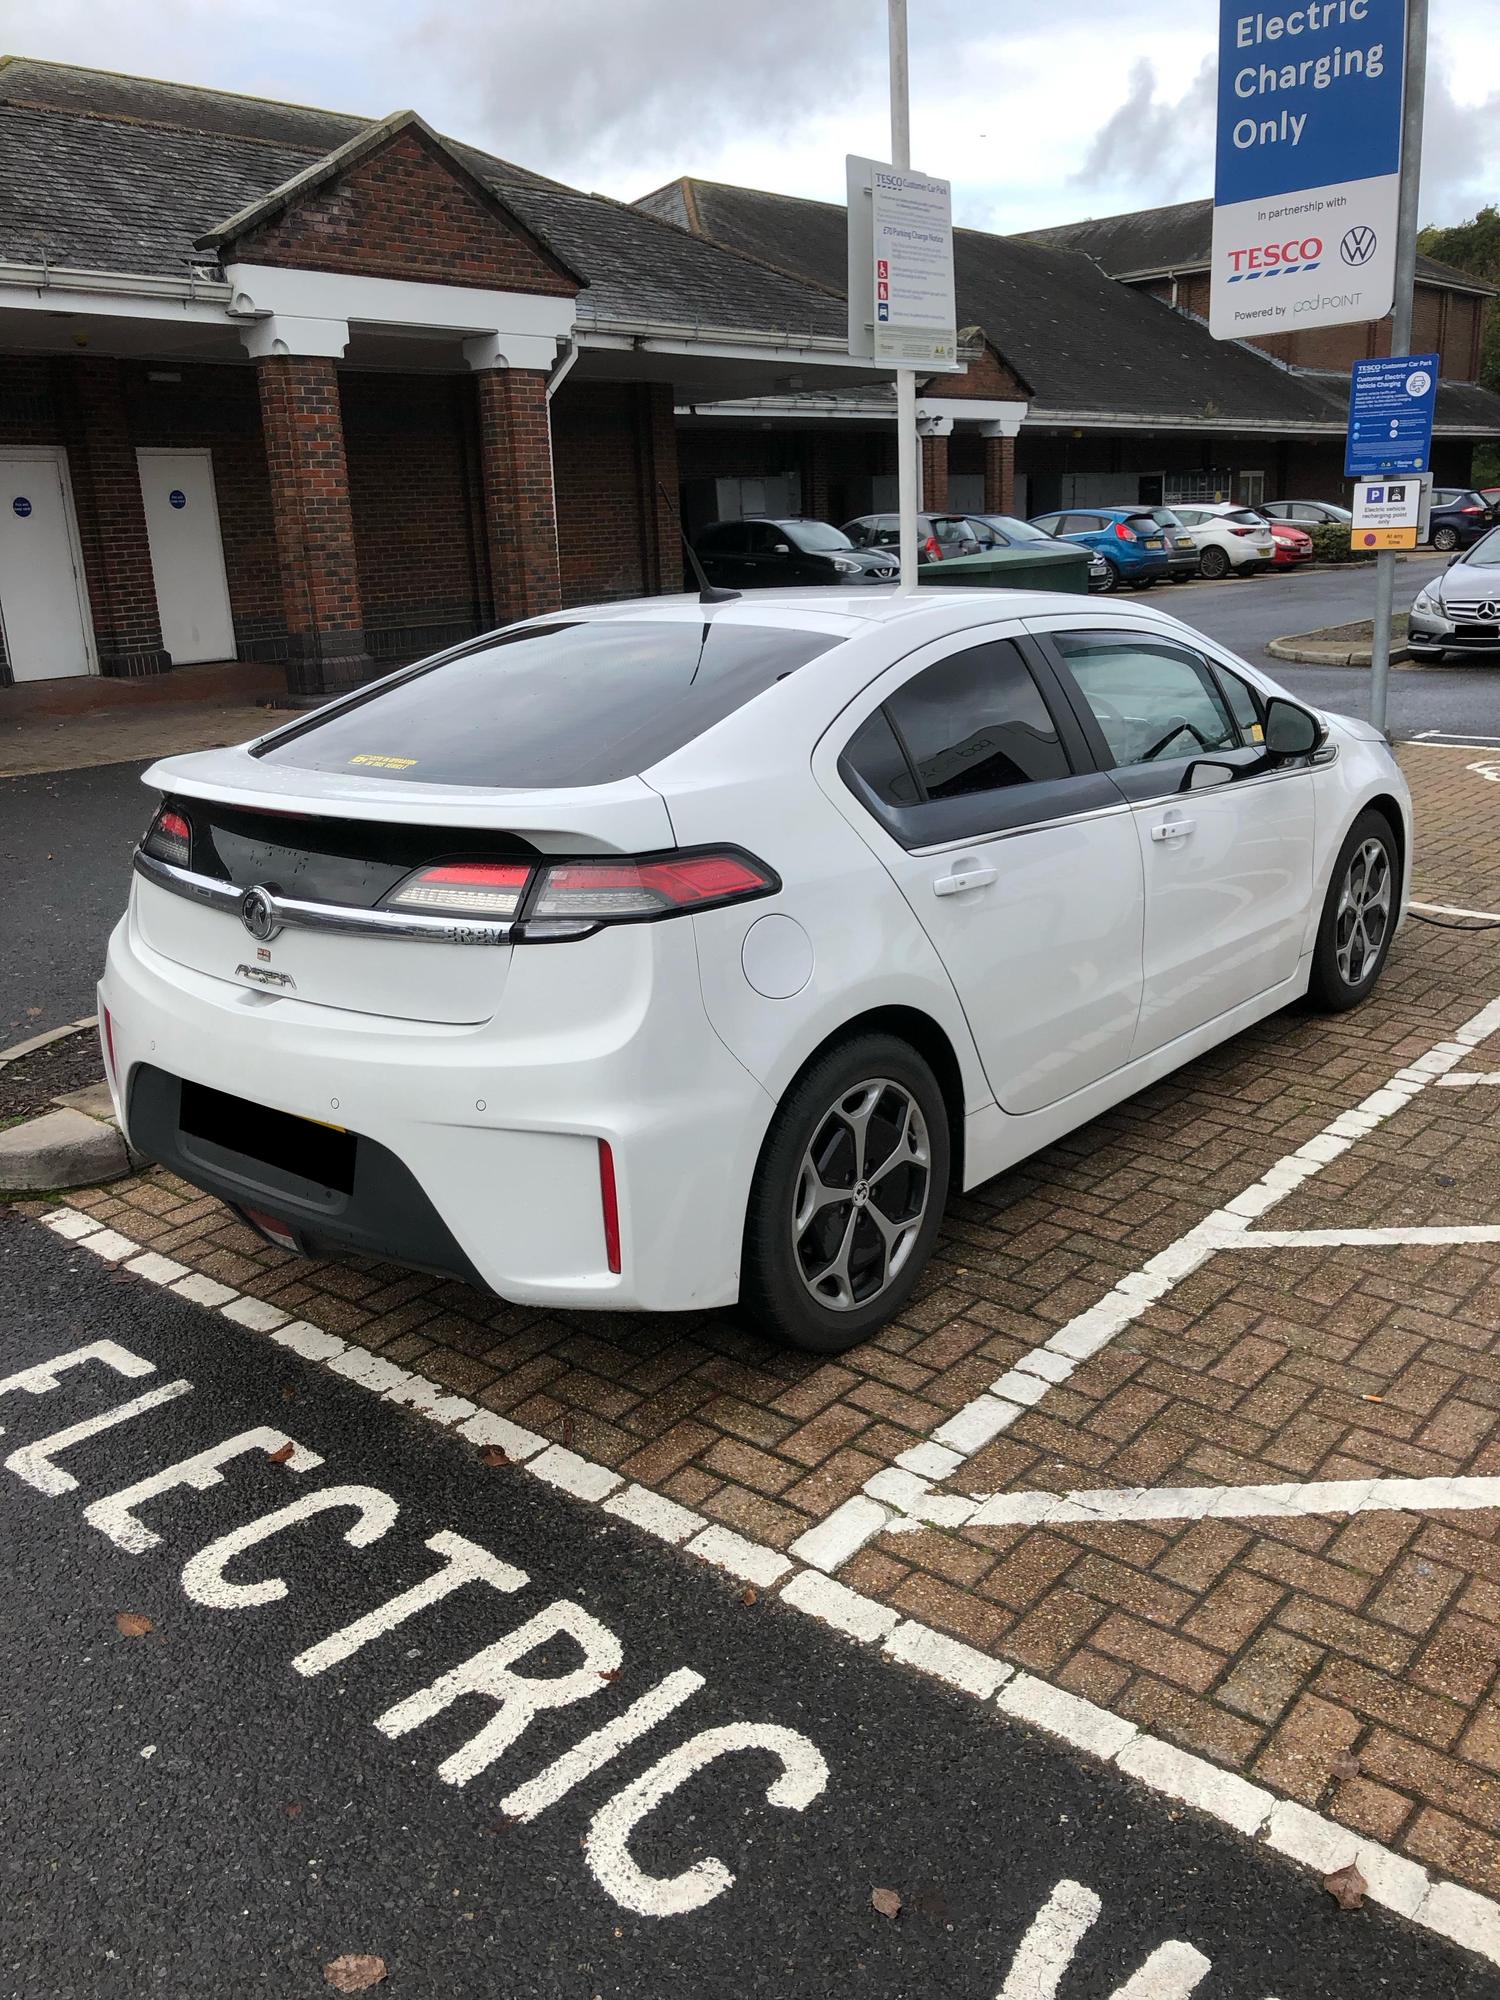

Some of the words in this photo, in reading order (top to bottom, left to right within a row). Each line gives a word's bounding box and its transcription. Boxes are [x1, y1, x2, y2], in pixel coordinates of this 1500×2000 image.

[1237, 0, 1369, 48] Electric
[1234, 43, 1384, 98] Charging
[1232, 110, 1308, 149] Only
[875, 173, 903, 187] TESCO
[1257, 211, 1267, 221] In
[1268, 200, 1324, 221] partnership
[1326, 196, 1347, 208] with
[1227, 237, 1323, 272] TESCO
[1234, 307, 1273, 320] Powered
[1275, 306, 1287, 316] by
[1321, 292, 1362, 309] POINT
[1382, 362, 1408, 370] Customer
[1371, 490, 1380, 501] P
[0, 1338, 829, 1917] ELECTRIC
